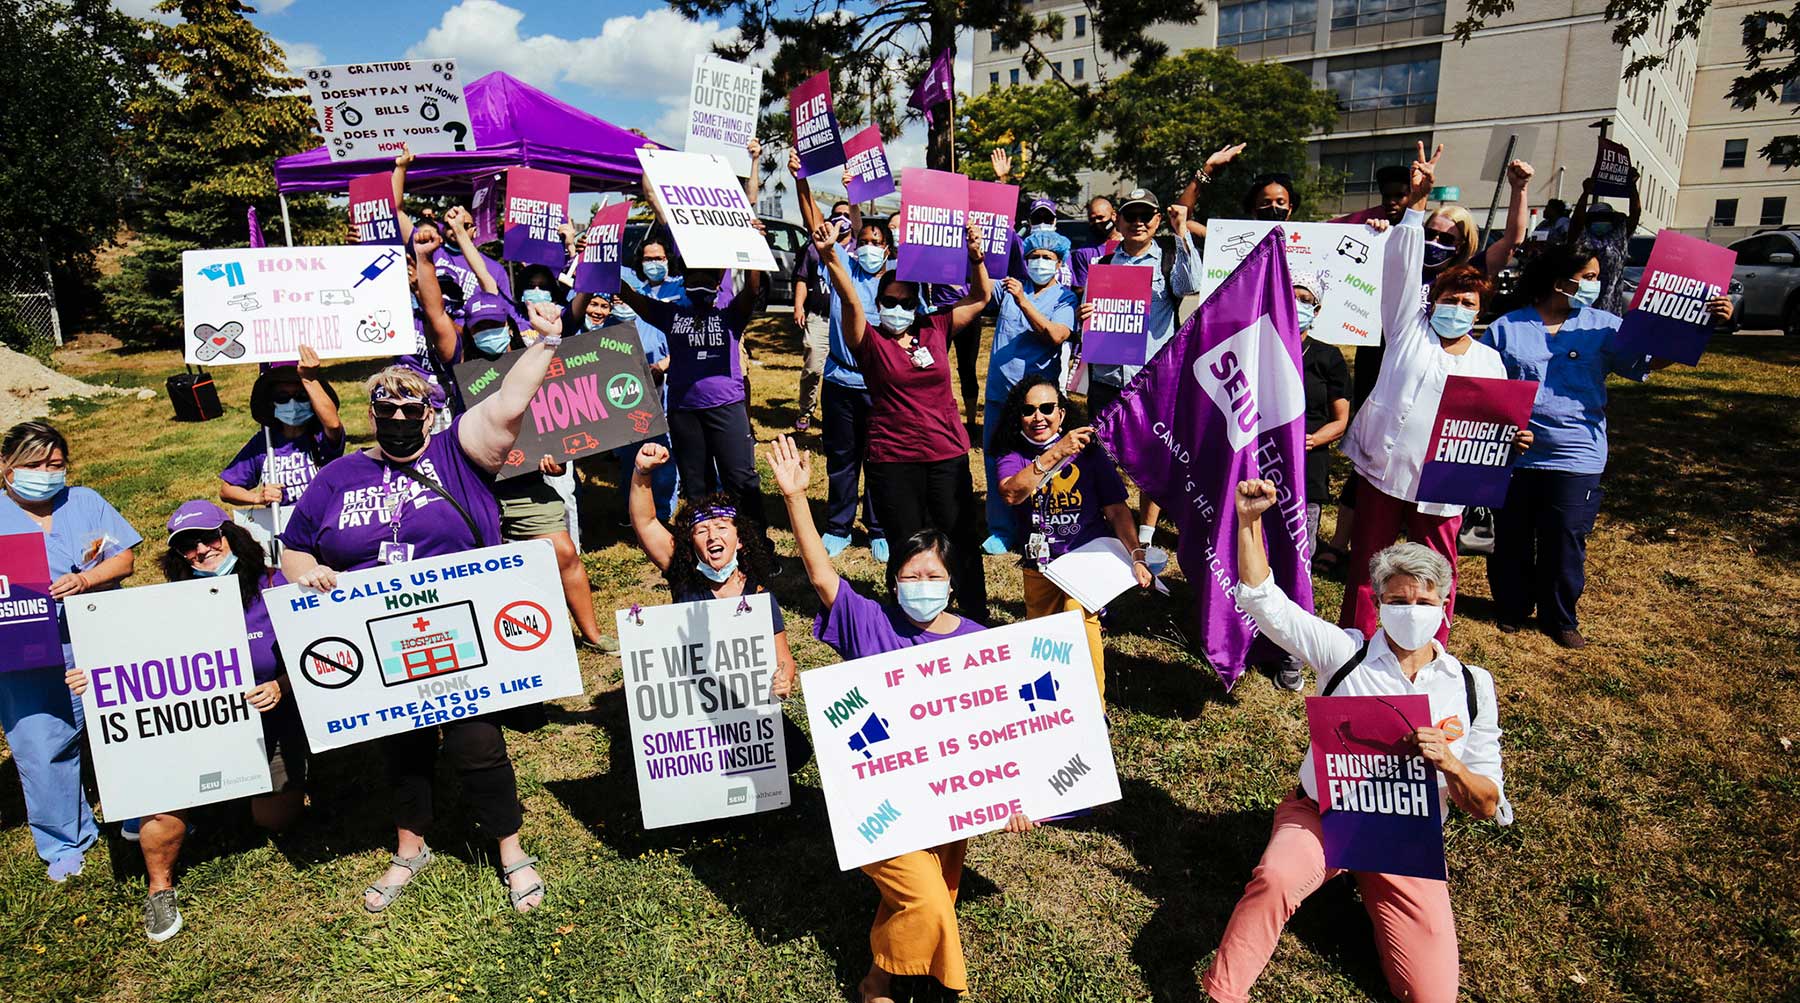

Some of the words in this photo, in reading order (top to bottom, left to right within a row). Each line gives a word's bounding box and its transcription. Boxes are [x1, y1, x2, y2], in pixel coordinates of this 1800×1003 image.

[348, 62, 411, 75] GRATITUDE
[321, 87, 377, 100] DOESN'T
[381, 85, 408, 96] PAY
[415, 83, 433, 93] MY
[696, 67, 709, 84] IF
[711, 70, 730, 90] WE
[733, 76, 758, 96] ARE
[435, 86, 459, 104] HONK
[694, 85, 755, 116] OUTSIDE
[324, 106, 334, 132] HONK
[375, 105, 409, 116] BILLS
[795, 100, 809, 126] LET
[811, 93, 828, 118] US
[344, 129, 377, 139] DOES
[384, 129, 395, 137] IT
[403, 126, 440, 136] YOURS
[692, 110, 742, 132] SOMETHING
[744, 121, 752, 134] IS
[796, 113, 831, 141] BARGAIN
[692, 123, 722, 140] WRONG
[724, 131, 751, 146] INSIDE
[811, 129, 834, 147] WAGES
[378, 142, 406, 152] HONK
[862, 170, 875, 183] PAY
[510, 197, 548, 215] RESPECT
[549, 203, 564, 217] US.
[660, 185, 746, 209] ENOUGH
[353, 198, 393, 224] REPEAL
[509, 210, 548, 227] PROTECT
[671, 208, 689, 225] IS
[691, 209, 751, 228] ENOUGH
[907, 205, 950, 225] ENOUGH
[952, 210, 964, 226] IS
[968, 210, 995, 226] SPECT
[995, 214, 1010, 228] US.
[376, 219, 396, 240] 124
[529, 226, 546, 240] PAY
[586, 223, 619, 244] REPEAL
[906, 222, 963, 248] ENOUGH
[993, 227, 1008, 242] US.
[584, 245, 601, 263] BILL
[603, 245, 618, 262] 124
[980, 240, 990, 252] AY
[992, 241, 1006, 255] US.
[258, 257, 327, 273] HONK
[1207, 269, 1231, 279] HON
[273, 288, 315, 303] For
[1344, 273, 1376, 296] HONK
[1648, 270, 1706, 298] ENOUGH
[1706, 284, 1722, 301] IS
[1092, 298, 1132, 313] ENOUGH
[1134, 300, 1146, 314] IS
[1343, 299, 1371, 319] HONK
[1638, 288, 1713, 326] ENOUGH
[253, 315, 342, 354] HEALTHCARE
[1090, 313, 1144, 334] ENOUGH
[1342, 321, 1369, 338] HONK
[600, 337, 633, 355] HONK
[688, 333, 705, 346] PAY
[709, 333, 724, 346] US.
[565, 351, 600, 369] HONK
[467, 367, 500, 396] HONK
[1209, 350, 1262, 434] SEIU
[529, 374, 609, 435] HONK
[1441, 419, 1499, 441] ENOUGH
[1500, 424, 1518, 442] IS
[1434, 438, 1512, 467] ENOUGH
[339, 510, 373, 530] PAY
[1032, 513, 1080, 525] READY
[1251, 437, 1313, 586] Healthca
[290, 594, 320, 612] HE
[330, 578, 402, 603] CALLS
[411, 570, 438, 586] US
[442, 554, 524, 580] HEROES
[385, 588, 439, 610] HONK
[400, 631, 453, 650] HOSPITAL
[1030, 636, 1073, 665] HONK
[630, 649, 654, 682] IF
[662, 643, 707, 678] WE
[715, 635, 767, 672] ARE
[884, 668, 905, 688] IF
[916, 656, 952, 678] WE
[963, 644, 1012, 670] ARE
[90, 647, 243, 708] ENOUGH
[417, 675, 472, 699] HONK
[327, 712, 370, 734] BUT
[376, 692, 461, 718] TREATS
[465, 686, 491, 701] US
[501, 675, 543, 694] LIKE
[635, 669, 771, 722] OUTSIDE
[823, 686, 869, 729] HONK
[909, 684, 1009, 720] OUTSIDE
[100, 712, 128, 745] IS
[135, 692, 250, 739] ENOUGH
[413, 703, 479, 729] ZEROS
[643, 720, 751, 756] SOMETHING
[757, 717, 774, 741] IS
[851, 746, 929, 780] THERE
[938, 737, 960, 758] IS
[968, 708, 1075, 751] SOMETHING
[646, 751, 714, 780] WRONG
[718, 742, 776, 770] INSIDE
[1325, 753, 1400, 779] ENOUGH
[1406, 755, 1427, 781] IS
[928, 761, 1021, 797] WRONG
[1048, 753, 1092, 797] HONK
[1329, 779, 1430, 817] ENOUGH
[856, 798, 903, 844] HONK
[948, 798, 1023, 832] INSIDE
